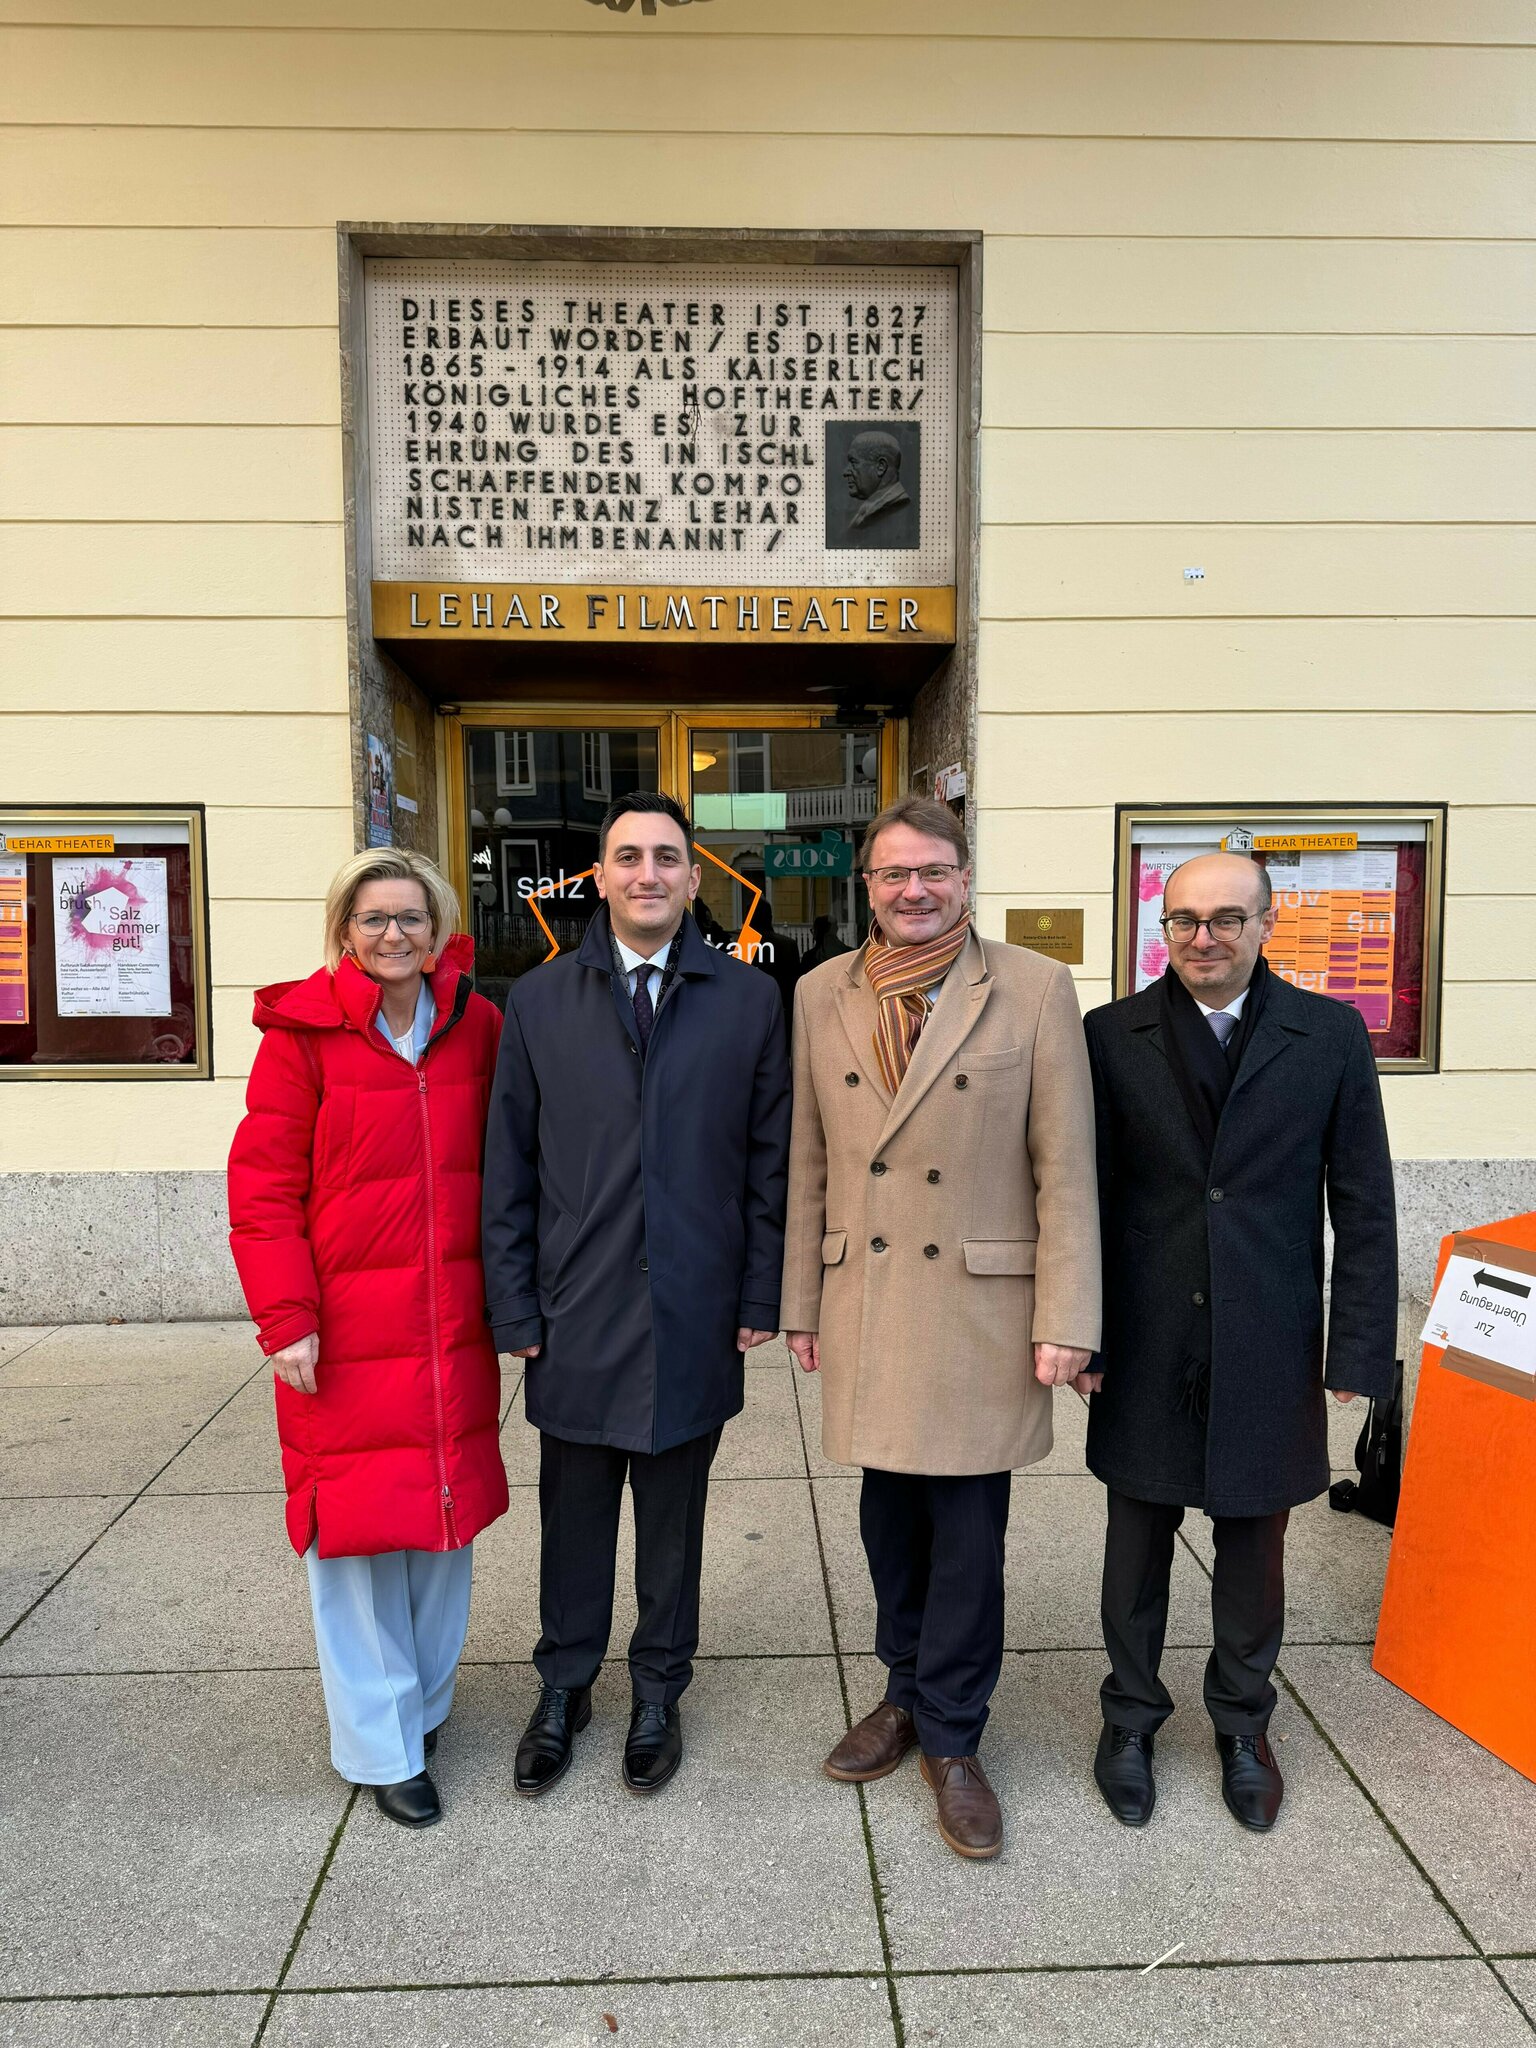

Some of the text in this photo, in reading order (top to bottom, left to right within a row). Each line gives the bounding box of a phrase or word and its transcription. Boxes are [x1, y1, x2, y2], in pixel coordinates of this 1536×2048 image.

[401, 298, 928, 329] DIESES THEATER IST 1827
[402, 326, 532, 351] ERBAUT
[549, 327, 692, 353] WORDEN
[747, 330, 780, 354] ES
[806, 331, 924, 356] DIENTE
[403, 353, 484, 378] 1865
[537, 354, 610, 379] 1914
[634, 357, 696, 381] ALS
[727, 357, 925, 382] KAISERLICH
[404, 380, 641, 408] KÖNIGLICHES
[407, 410, 802, 438] 1940 WURDE ES ZUR
[405, 439, 814, 466] EHRUNG DES IN ISCHL
[408, 468, 803, 497] SCHAFFENDEN KOMPO
[406, 495, 799, 524] NISTEN FRANZ LEHAR
[407, 524, 502, 548] NACH
[410, 592, 922, 632] LEHAR FILMTHEATER
[12, 838, 112, 850] LEHAR THEATER
[1257, 836, 1355, 848] LEHAR THEATER
[1146, 862, 1183, 871] WIRTSH
[60, 881, 86, 895] Auf
[517, 868, 585, 899] salz
[60, 896, 106, 911] bruch,
[109, 906, 141, 921] Salz
[99, 920, 161, 934] kammer
[112, 935, 141, 952] gut!
[1459, 1290, 1528, 1328] Übertragung
[1474, 1320, 1496, 1338] Zur
